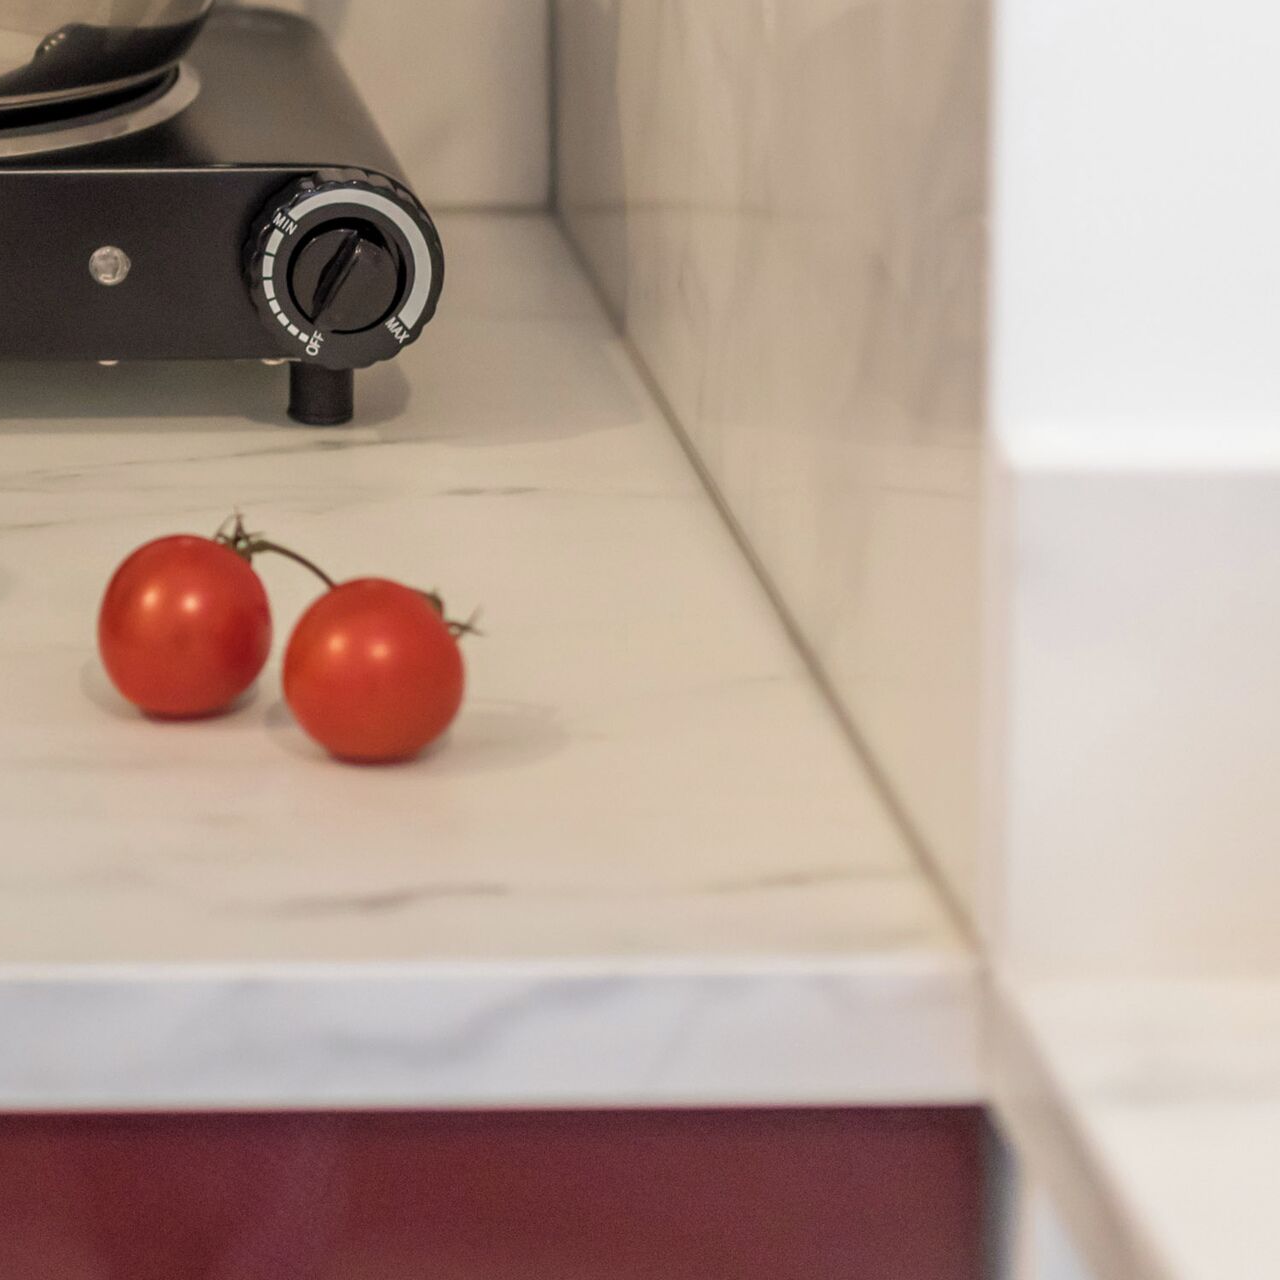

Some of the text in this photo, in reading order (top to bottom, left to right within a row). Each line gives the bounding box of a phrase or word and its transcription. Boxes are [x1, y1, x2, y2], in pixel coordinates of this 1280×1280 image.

[272, 212, 298, 236] MIN
[305, 330, 325, 356] OFF
[384, 316, 410, 344] MAX
